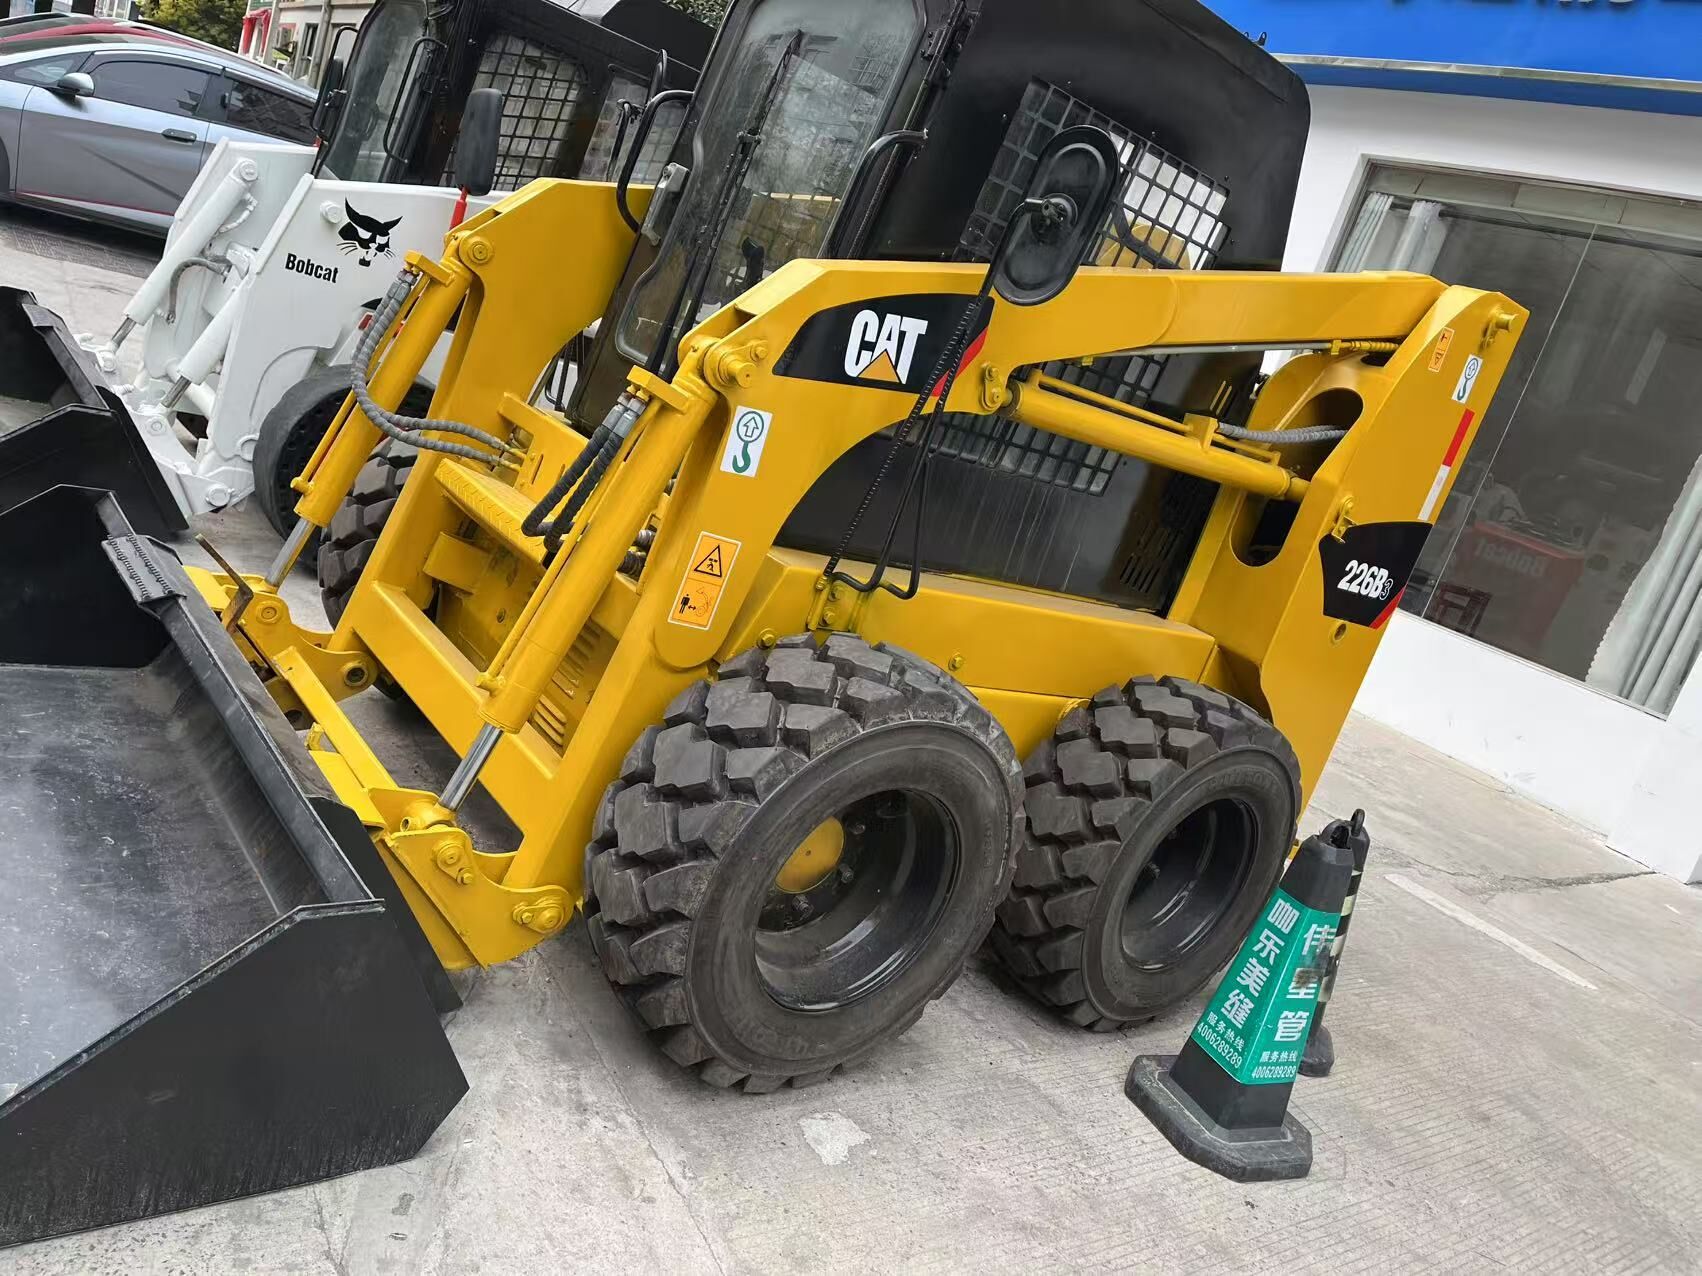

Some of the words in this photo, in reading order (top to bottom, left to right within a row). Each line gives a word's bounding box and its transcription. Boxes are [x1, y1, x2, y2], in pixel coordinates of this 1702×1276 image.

[285, 253, 339, 283] Bobcat
[844, 309, 928, 385] CAT
[1220, 898, 1300, 1029] 咖乐美缝
[1197, 1022, 1243, 1069] 4006289289
[1206, 1011, 1245, 1051] 服务热线
[1251, 1066, 1297, 1079] 4006289289
[1260, 1051, 1298, 1063] 服务热线
